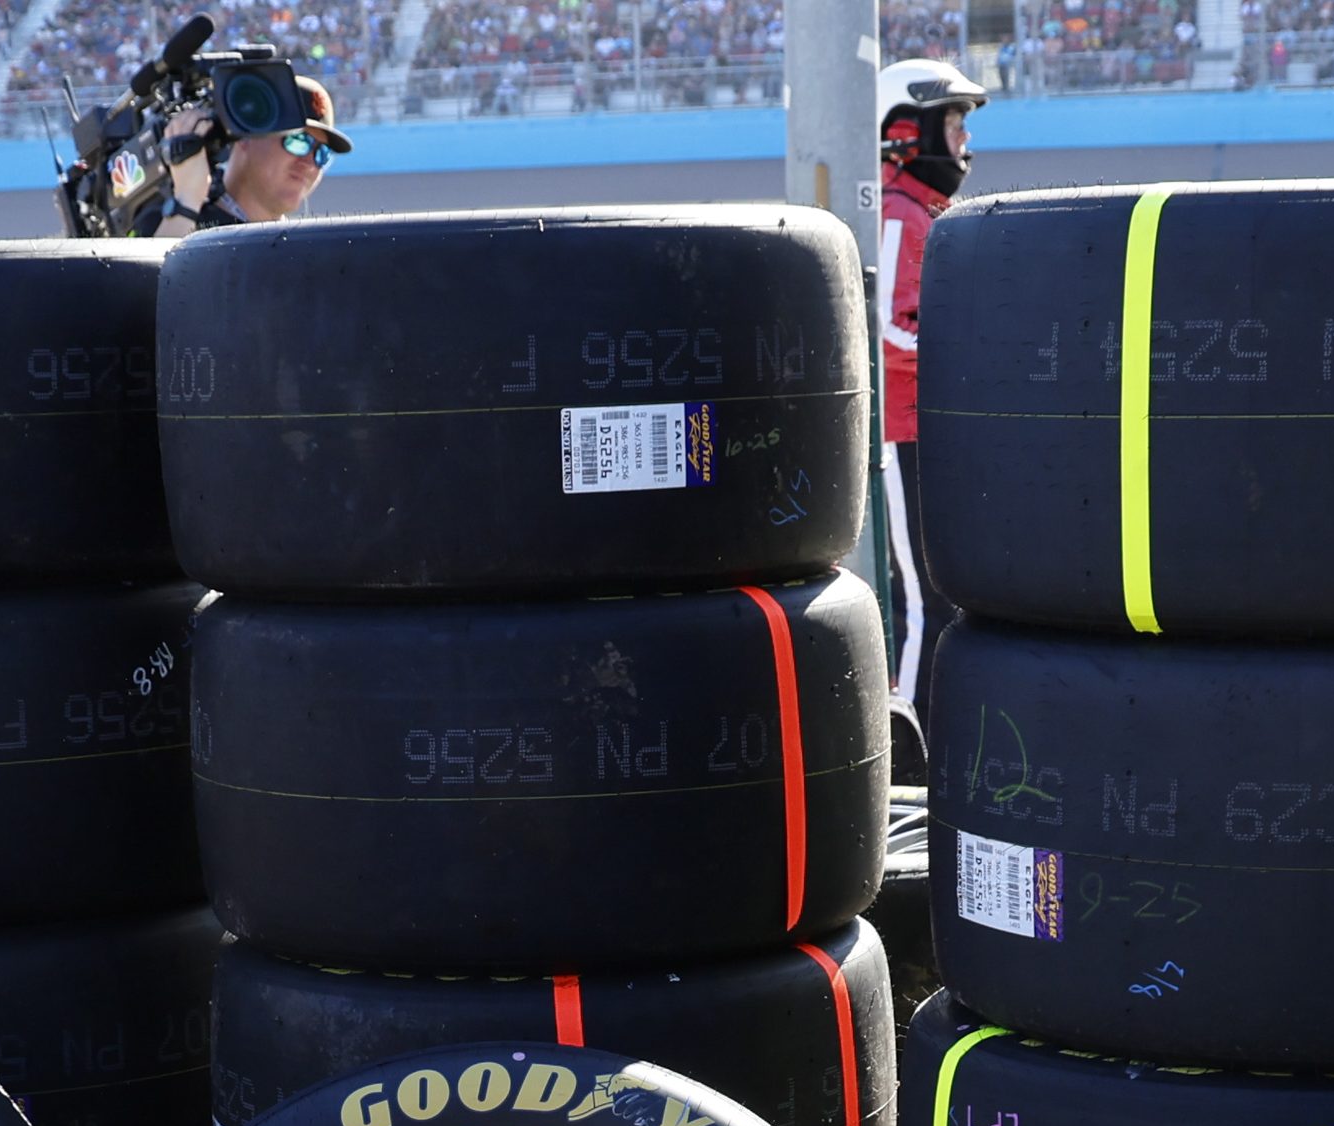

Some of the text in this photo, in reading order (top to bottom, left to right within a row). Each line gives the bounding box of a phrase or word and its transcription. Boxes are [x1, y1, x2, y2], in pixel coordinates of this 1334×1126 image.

[26, 345, 155, 401] 5256
[501, 332, 537, 393] F
[580, 326, 725, 392] 5256
[1027, 320, 1060, 382] F
[564, 454, 574, 491] CRUSH
[600, 425, 613, 479] D5256
[675, 419, 683, 473] EAGLE
[402, 726, 556, 786] 5256
[595, 718, 669, 780] PN
[1101, 772, 1178, 840] PN
[1025, 865, 1033, 922] EAGLE
